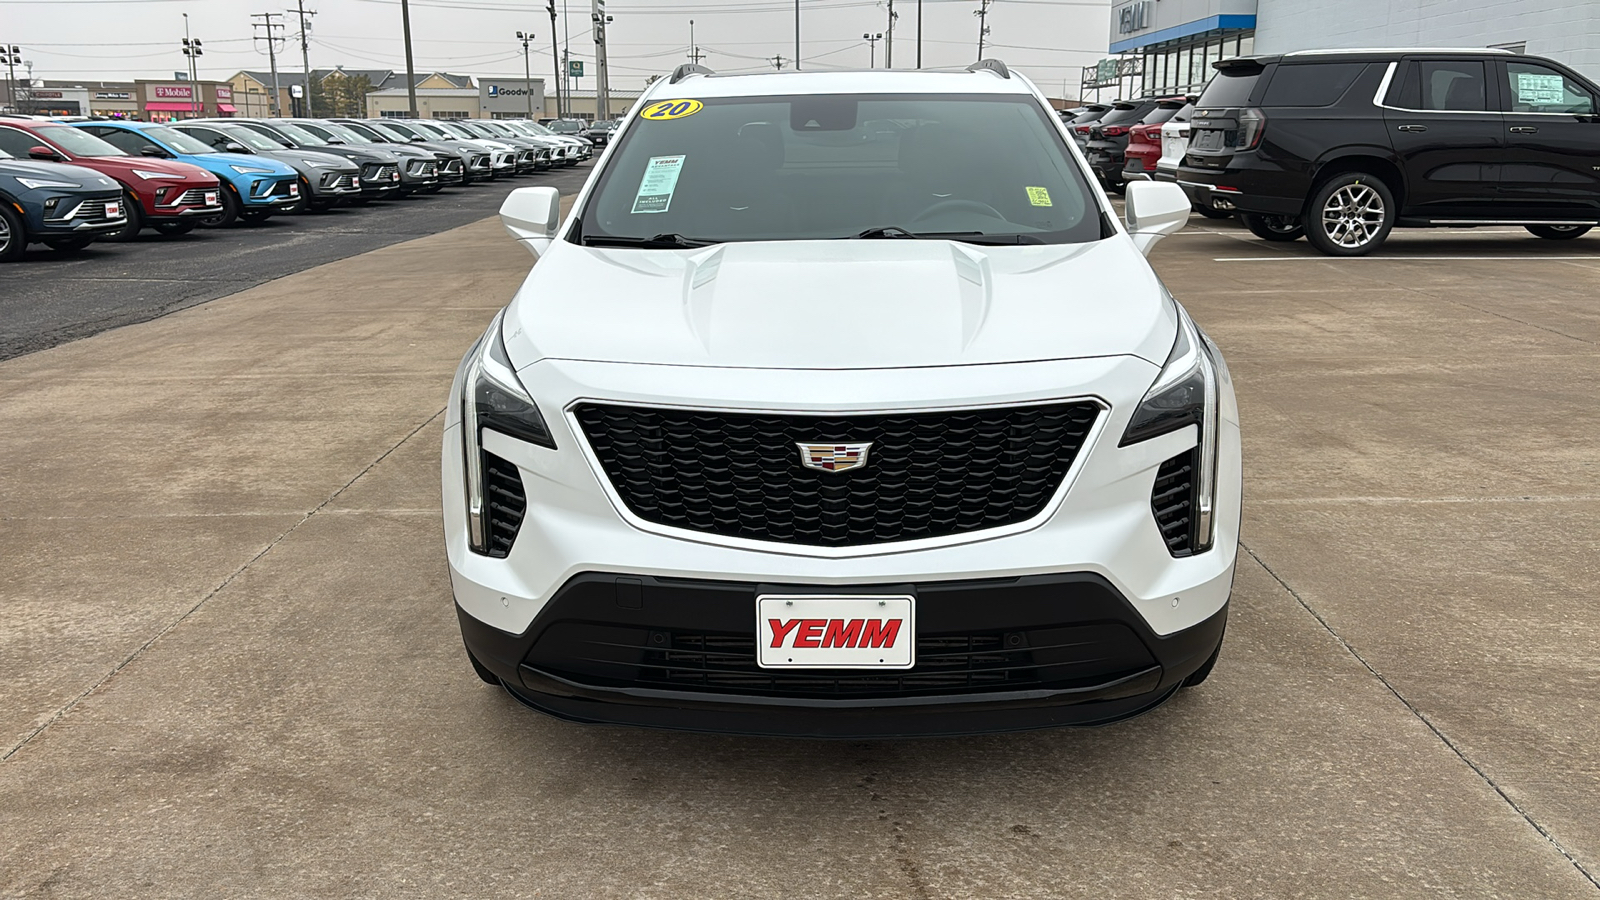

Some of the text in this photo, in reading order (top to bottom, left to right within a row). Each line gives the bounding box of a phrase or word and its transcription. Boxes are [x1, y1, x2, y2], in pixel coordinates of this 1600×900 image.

[499, 88, 534, 96] Goodwll
[650, 102, 691, 117] 20
[768, 618, 903, 648] YEMM
